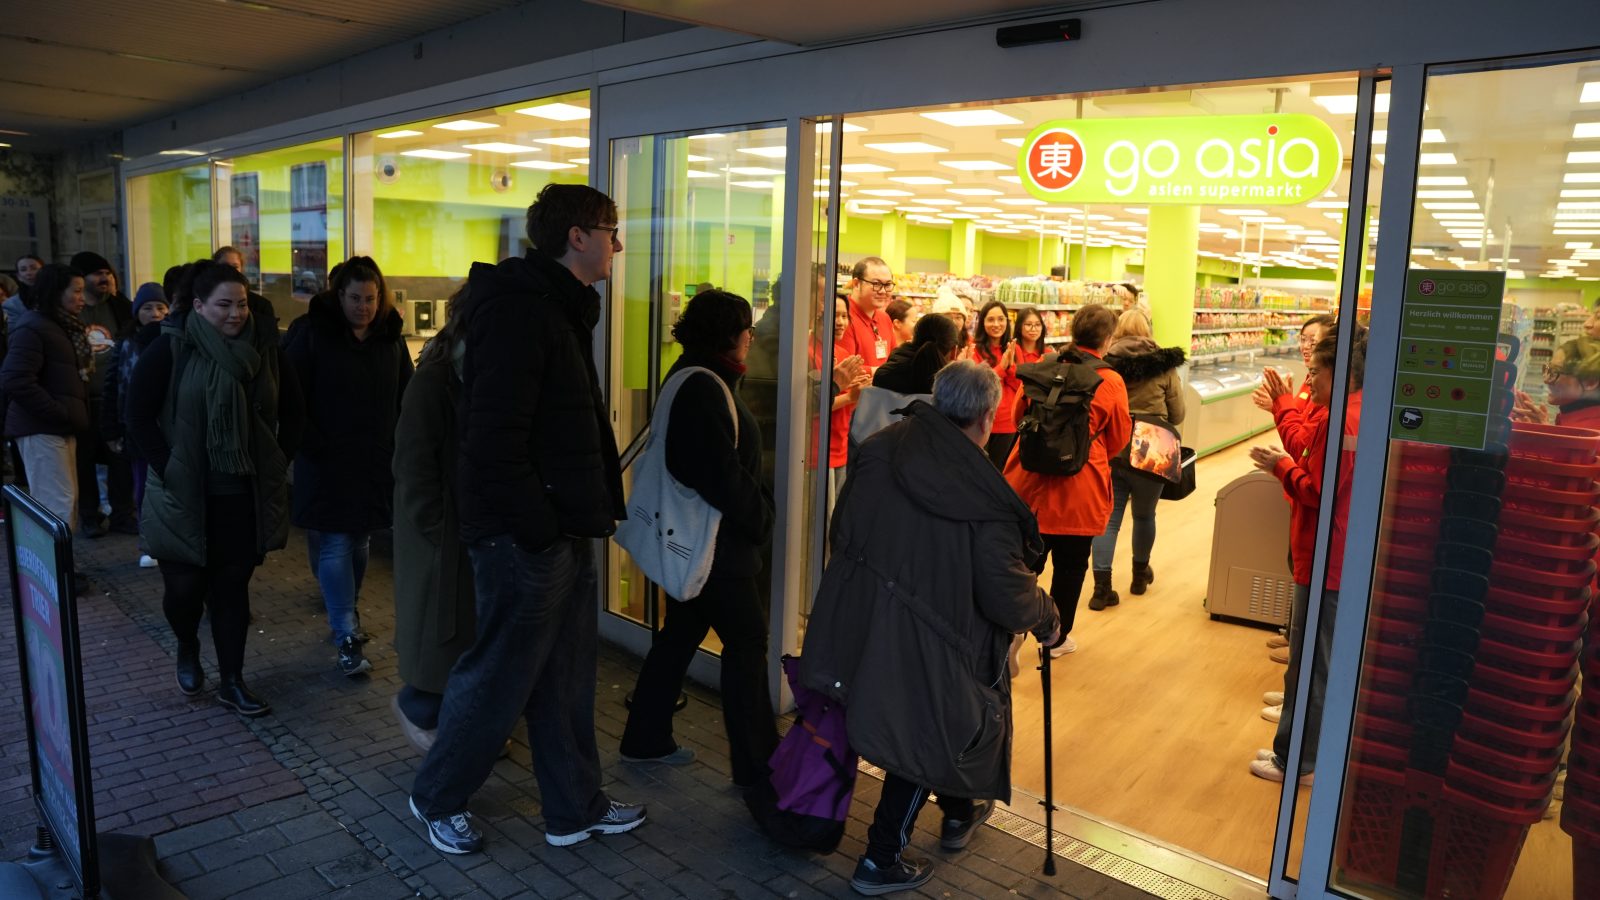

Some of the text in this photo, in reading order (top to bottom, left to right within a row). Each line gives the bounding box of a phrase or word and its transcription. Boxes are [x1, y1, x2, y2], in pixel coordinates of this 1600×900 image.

[1037, 141, 1074, 179] 東
[1103, 125, 1320, 197] go asia
[1148, 181, 1303, 200] asien supermarkt
[1437, 281, 1487, 295] go asia
[1409, 309, 1494, 321] Herzlich willkommen
[28, 581, 51, 629] TRIER
